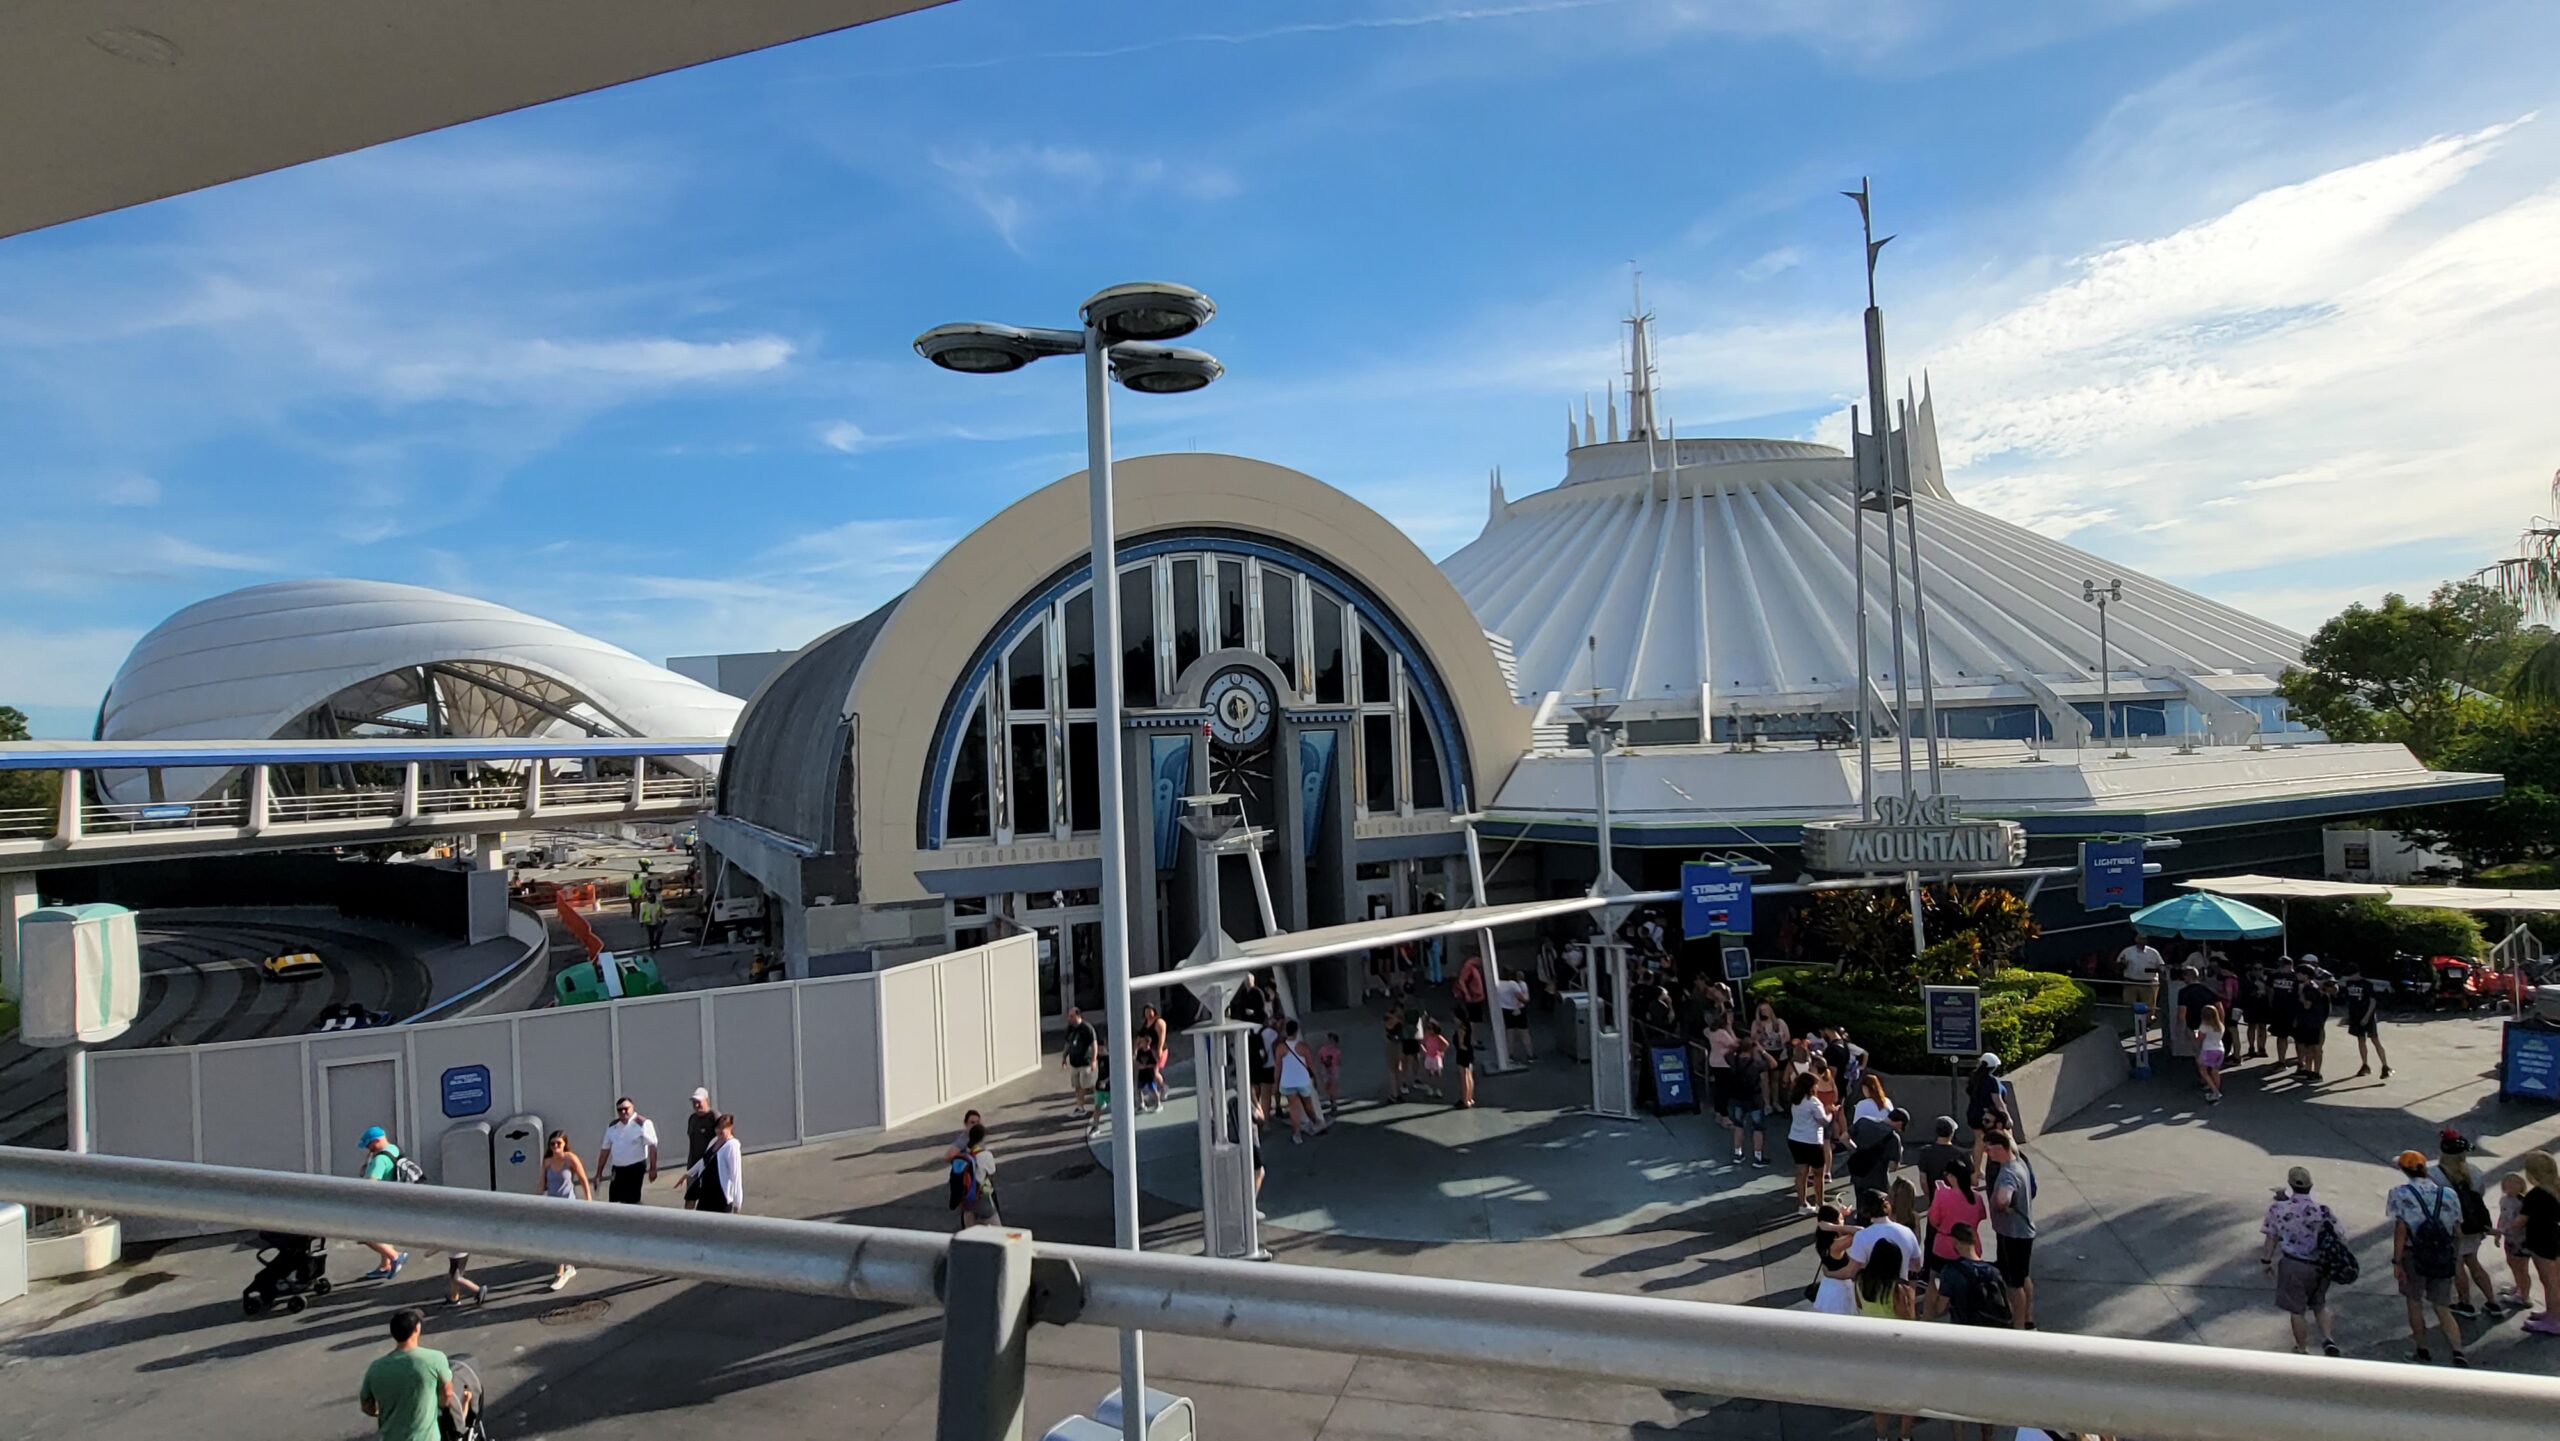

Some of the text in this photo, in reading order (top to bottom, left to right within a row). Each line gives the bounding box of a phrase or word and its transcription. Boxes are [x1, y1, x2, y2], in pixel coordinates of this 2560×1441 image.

[1875, 791, 1960, 826] SPACE
[954, 842, 1099, 865] TOMORROWLAN
[1848, 829, 2000, 863] MOUNTAIN
[1691, 882, 1743, 895] STAND-BY
